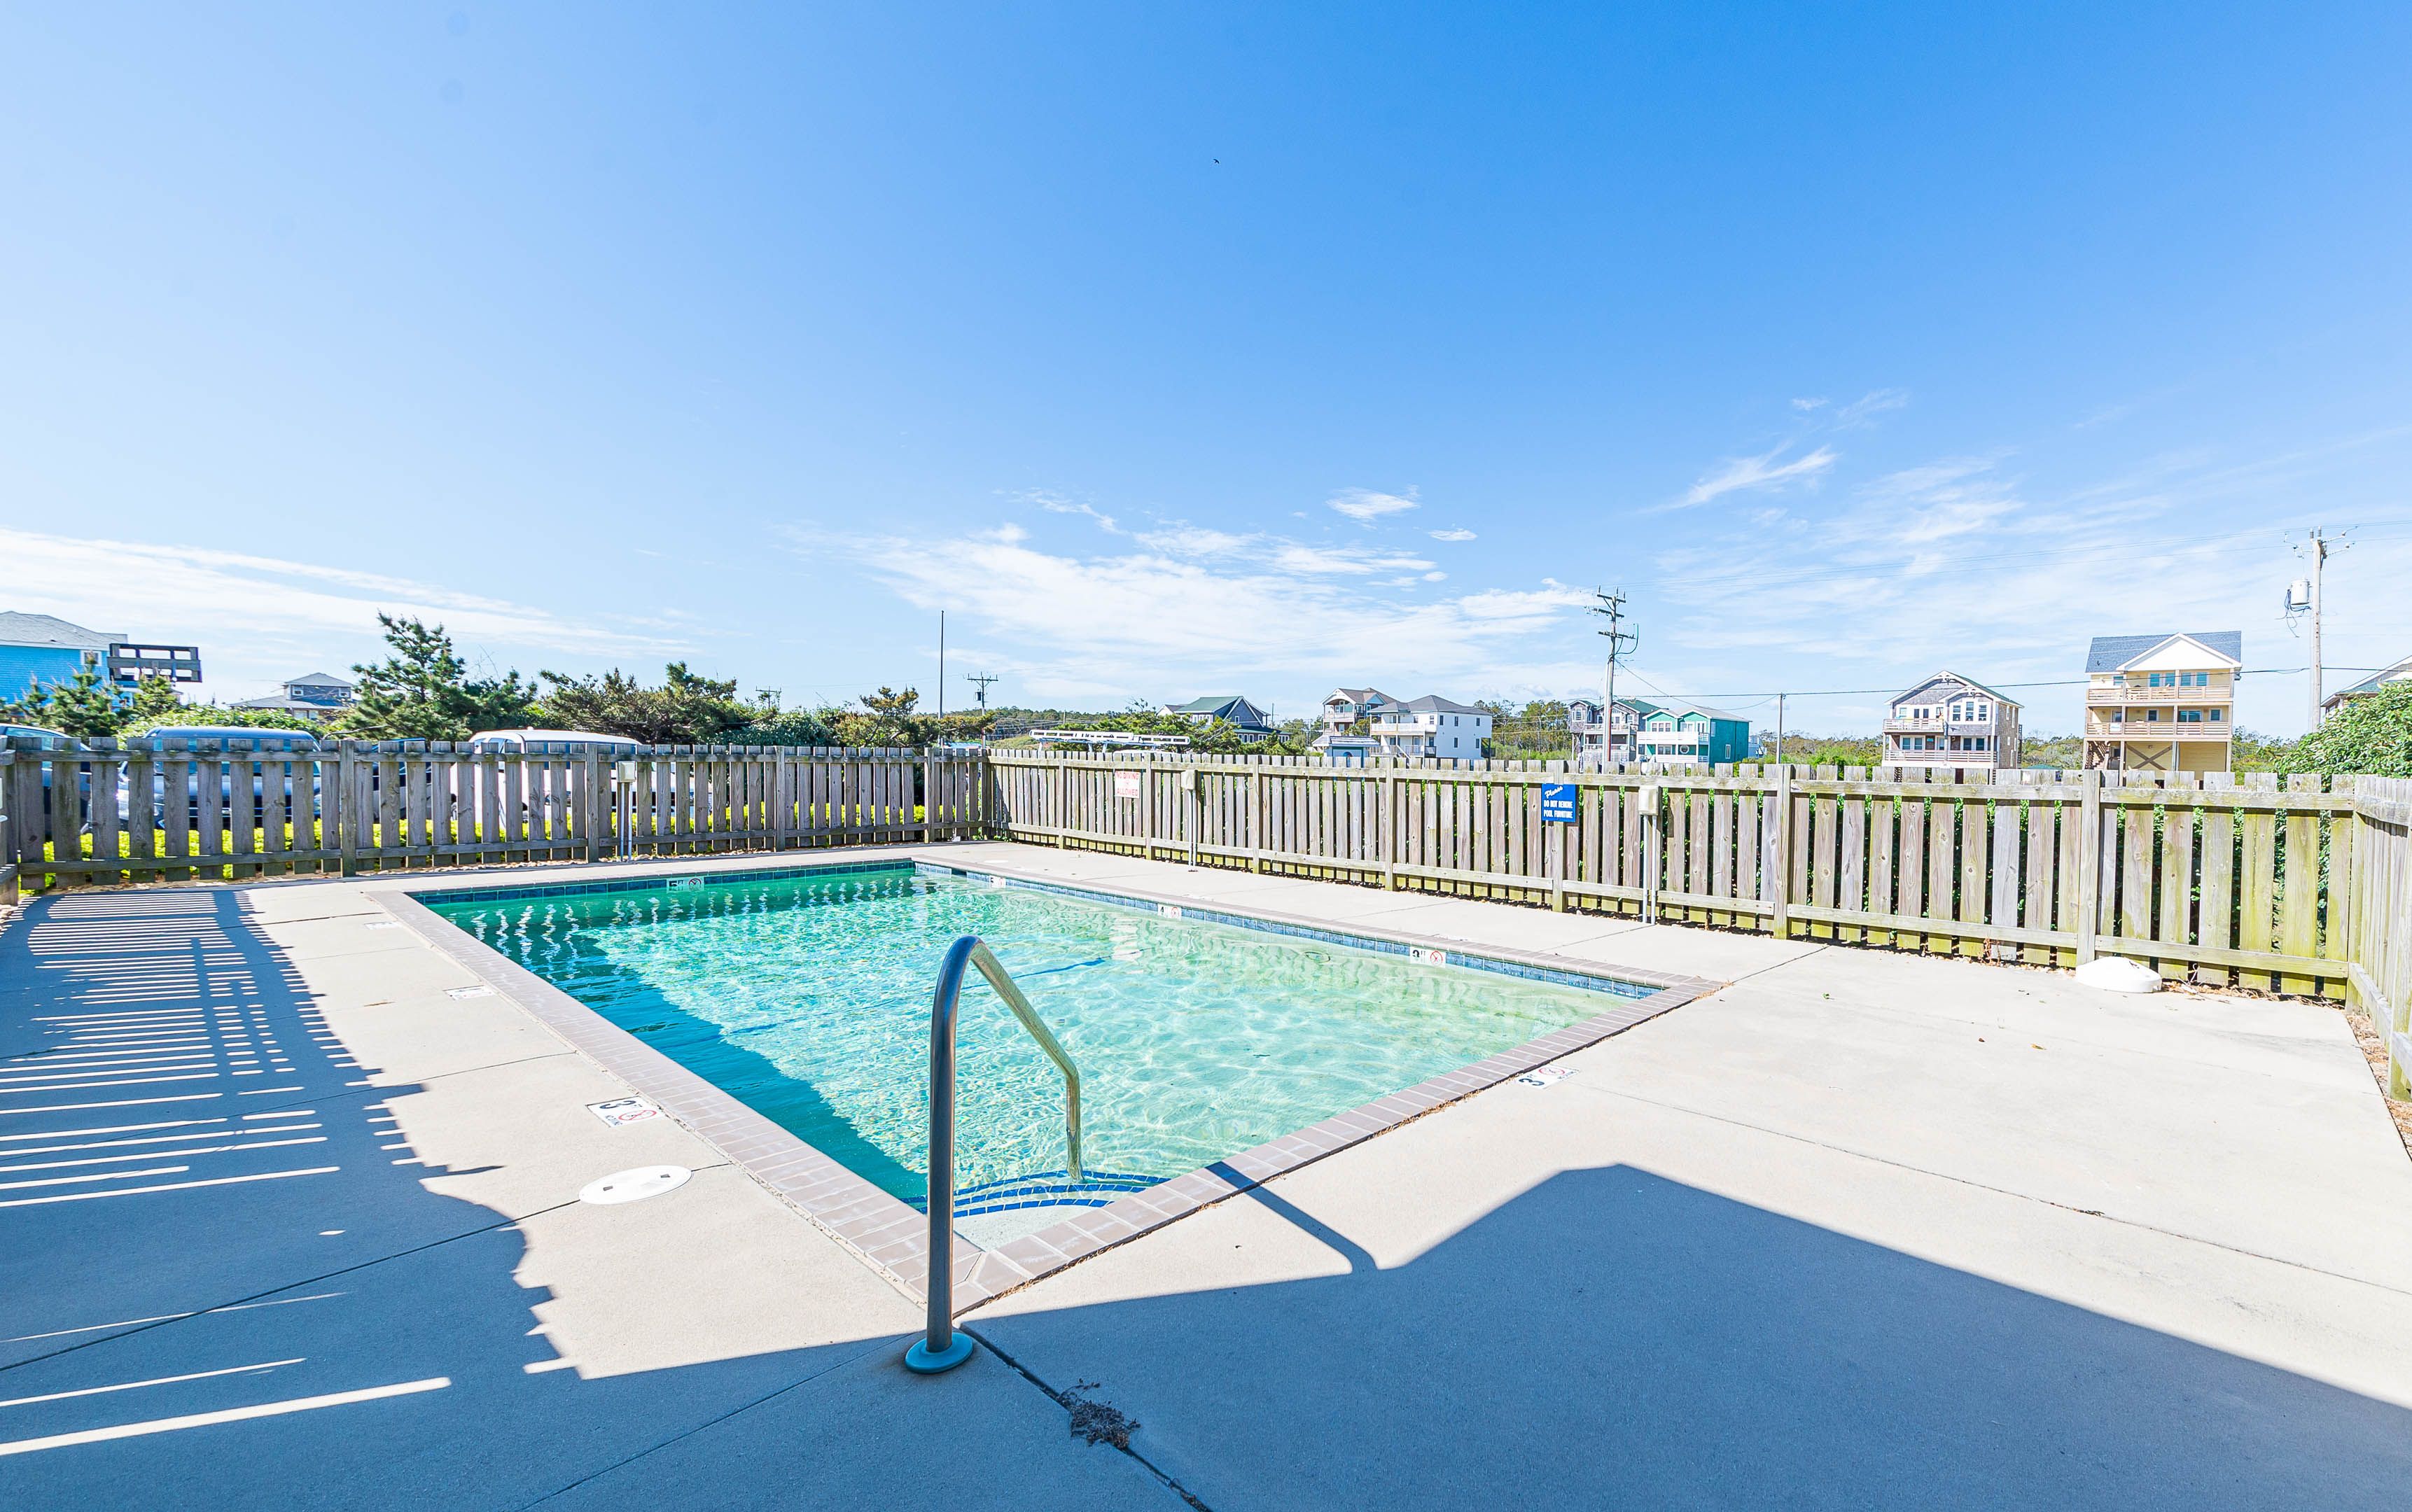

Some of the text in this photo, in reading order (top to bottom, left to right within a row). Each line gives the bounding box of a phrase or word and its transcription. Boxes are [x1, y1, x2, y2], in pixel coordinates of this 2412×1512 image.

[1116, 787, 1138, 796] ALLOWED
[1554, 810, 1573, 818] FURNITURE
[1519, 1078, 1545, 1086] 3
[599, 1100, 636, 1109] 3
